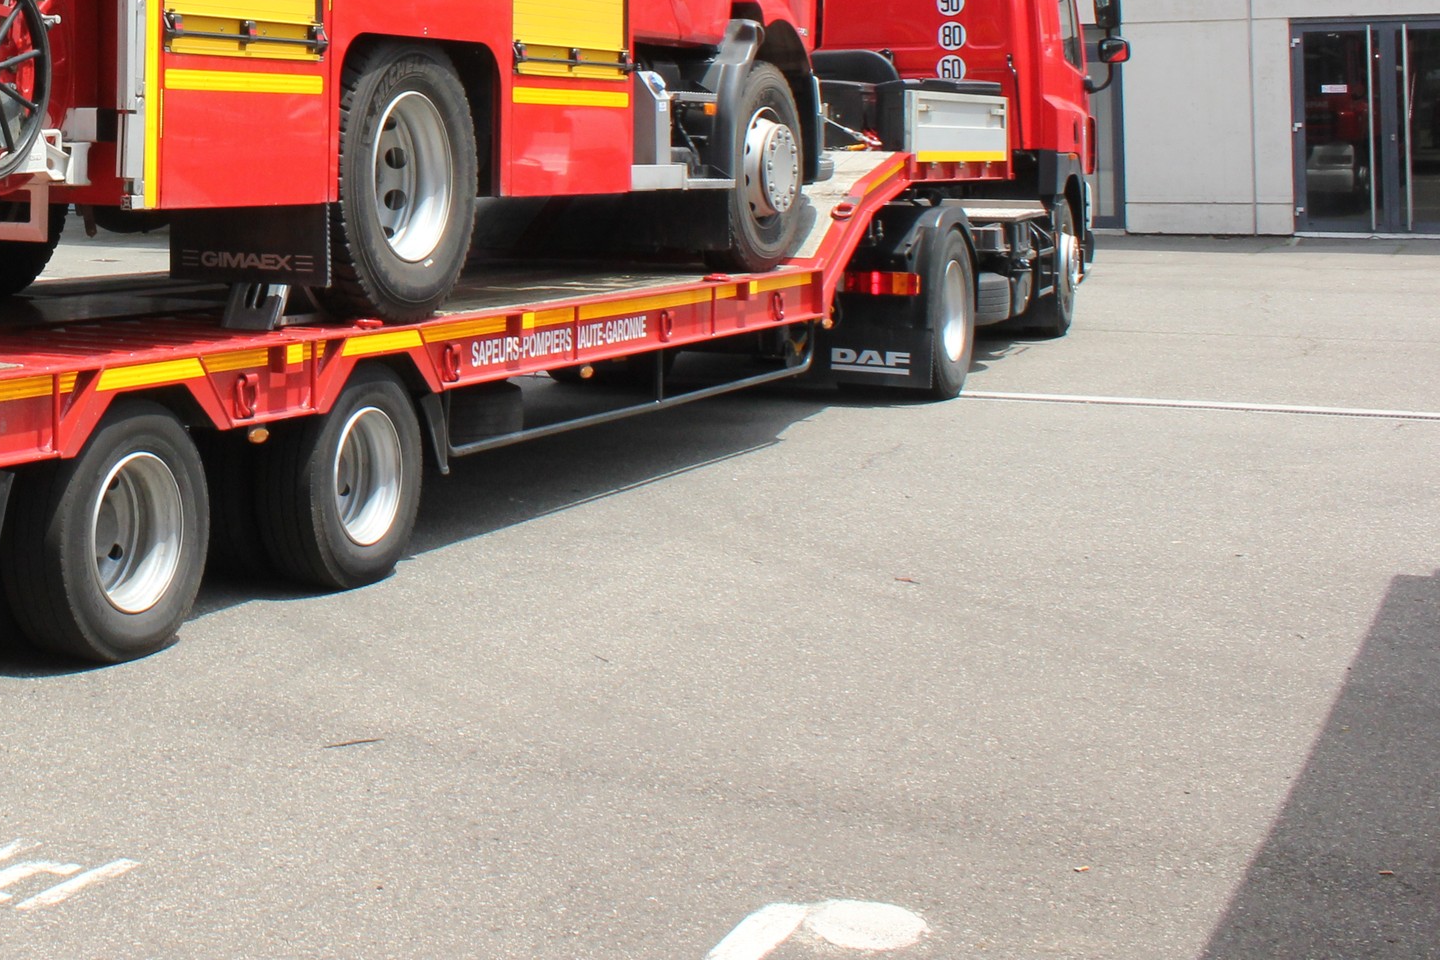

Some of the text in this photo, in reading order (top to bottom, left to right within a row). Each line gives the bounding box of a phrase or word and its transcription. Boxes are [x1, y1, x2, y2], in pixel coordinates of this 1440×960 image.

[942, 25, 962, 47] 80
[941, 58, 961, 79] 60
[200, 250, 293, 272] GIMAEX
[471, 327, 573, 368] SAPEURS-POMPIERS
[830, 347, 911, 368] DAF
